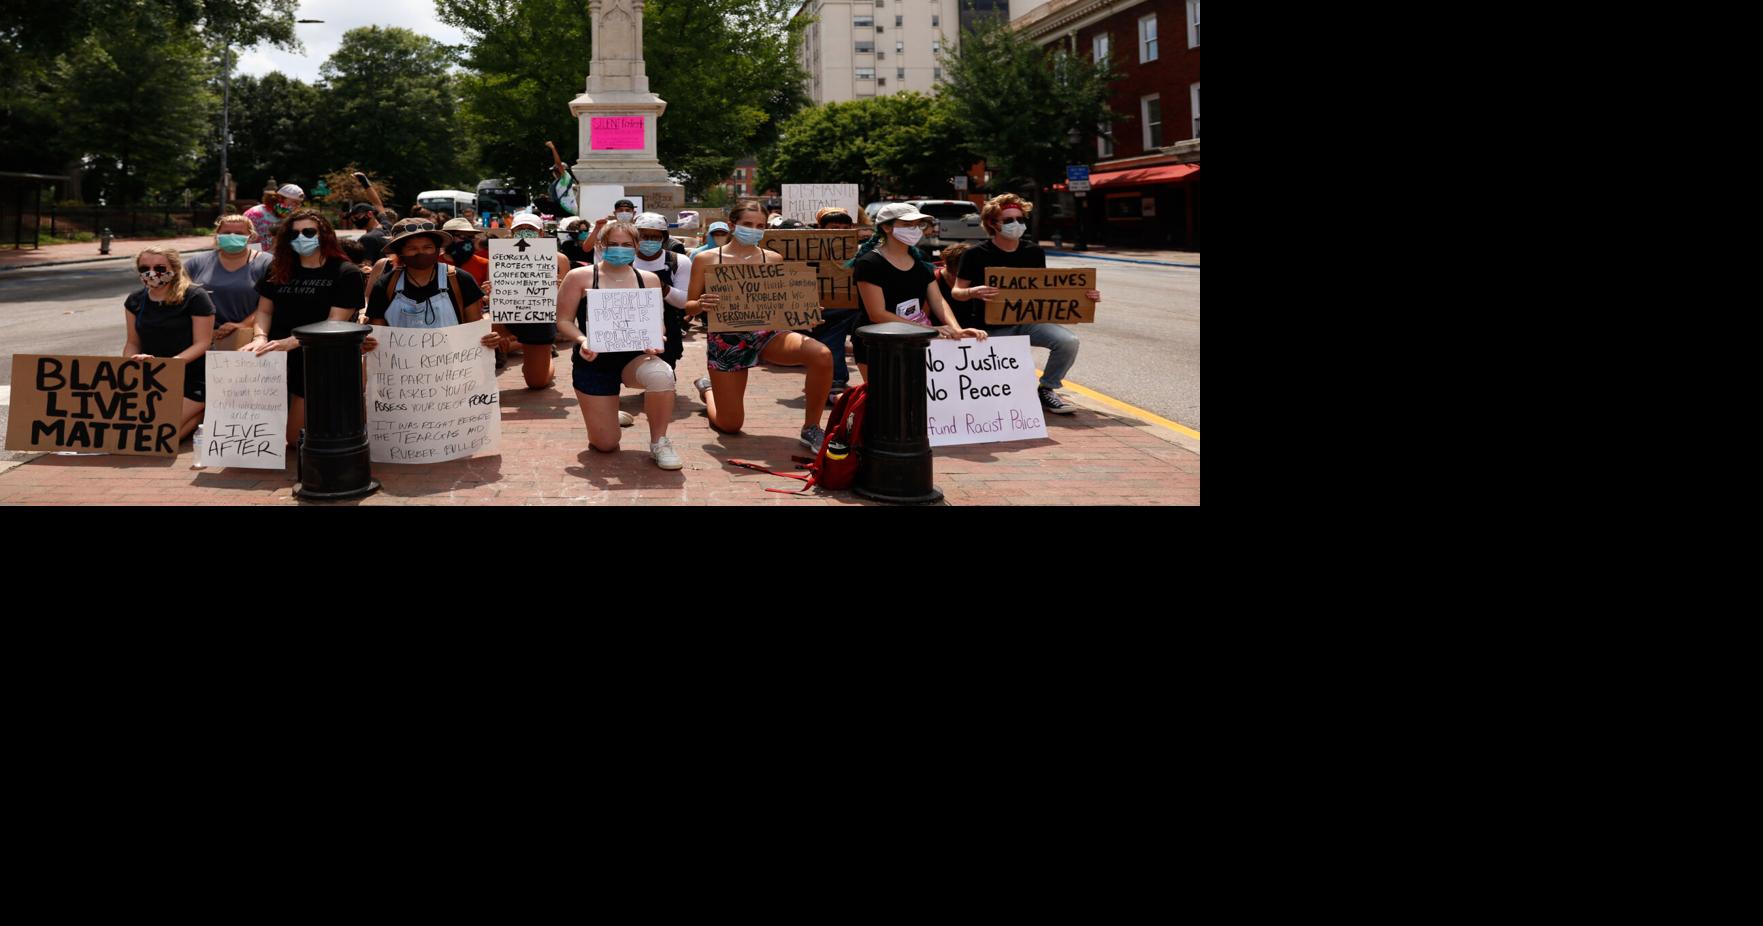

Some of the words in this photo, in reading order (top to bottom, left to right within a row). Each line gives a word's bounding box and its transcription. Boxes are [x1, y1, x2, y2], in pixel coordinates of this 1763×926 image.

[789, 199, 839, 212] MILITANT
[492, 253, 530, 261] GEORGIA
[766, 237, 855, 261] SILENCE
[493, 271, 553, 279] CONFEDERATE
[714, 263, 784, 283] PRIVILEGE
[988, 275, 1039, 289] BLACK
[1043, 273, 1087, 287] LIVES
[494, 279, 539, 287] MONUMENT
[526, 287, 549, 296] NOT
[737, 281, 760, 294] YOU
[492, 297, 525, 306] PROTECT
[602, 291, 654, 310] PEOPLE
[746, 292, 787, 303] PROBLEM
[492, 310, 522, 322] HATE
[594, 306, 650, 322] POWER
[784, 308, 821, 327] BLM
[1001, 298, 1082, 322] MATTER
[373, 350, 414, 369] Y'ALL
[420, 347, 483, 368] REMEMBER
[955, 346, 1019, 372] Justice
[36, 357, 168, 392] BLACK
[375, 372, 394, 386] THE
[400, 372, 433, 386] PART
[435, 366, 473, 382] WHERE
[377, 388, 394, 400] WE
[399, 388, 437, 400] ASKED
[441, 383, 460, 397] YOU
[460, 380, 476, 394] TO
[959, 374, 1012, 400] Peace
[46, 391, 162, 423] LIVES
[411, 401, 435, 412] YOUR
[468, 393, 499, 408] FORCE
[213, 420, 277, 438] LIVE
[373, 420, 396, 431] IT
[399, 421, 419, 430] WAS
[421, 419, 456, 430] RIGHT
[928, 415, 957, 436] fund
[965, 410, 1004, 435] Racist
[1009, 408, 1041, 431] Police
[31, 419, 177, 454] MATTER
[372, 431, 390, 442] THE
[467, 425, 485, 436] AND
[208, 438, 282, 457] AFTER
[390, 446, 441, 460] RUBBER
[444, 437, 492, 456] BULLETS
